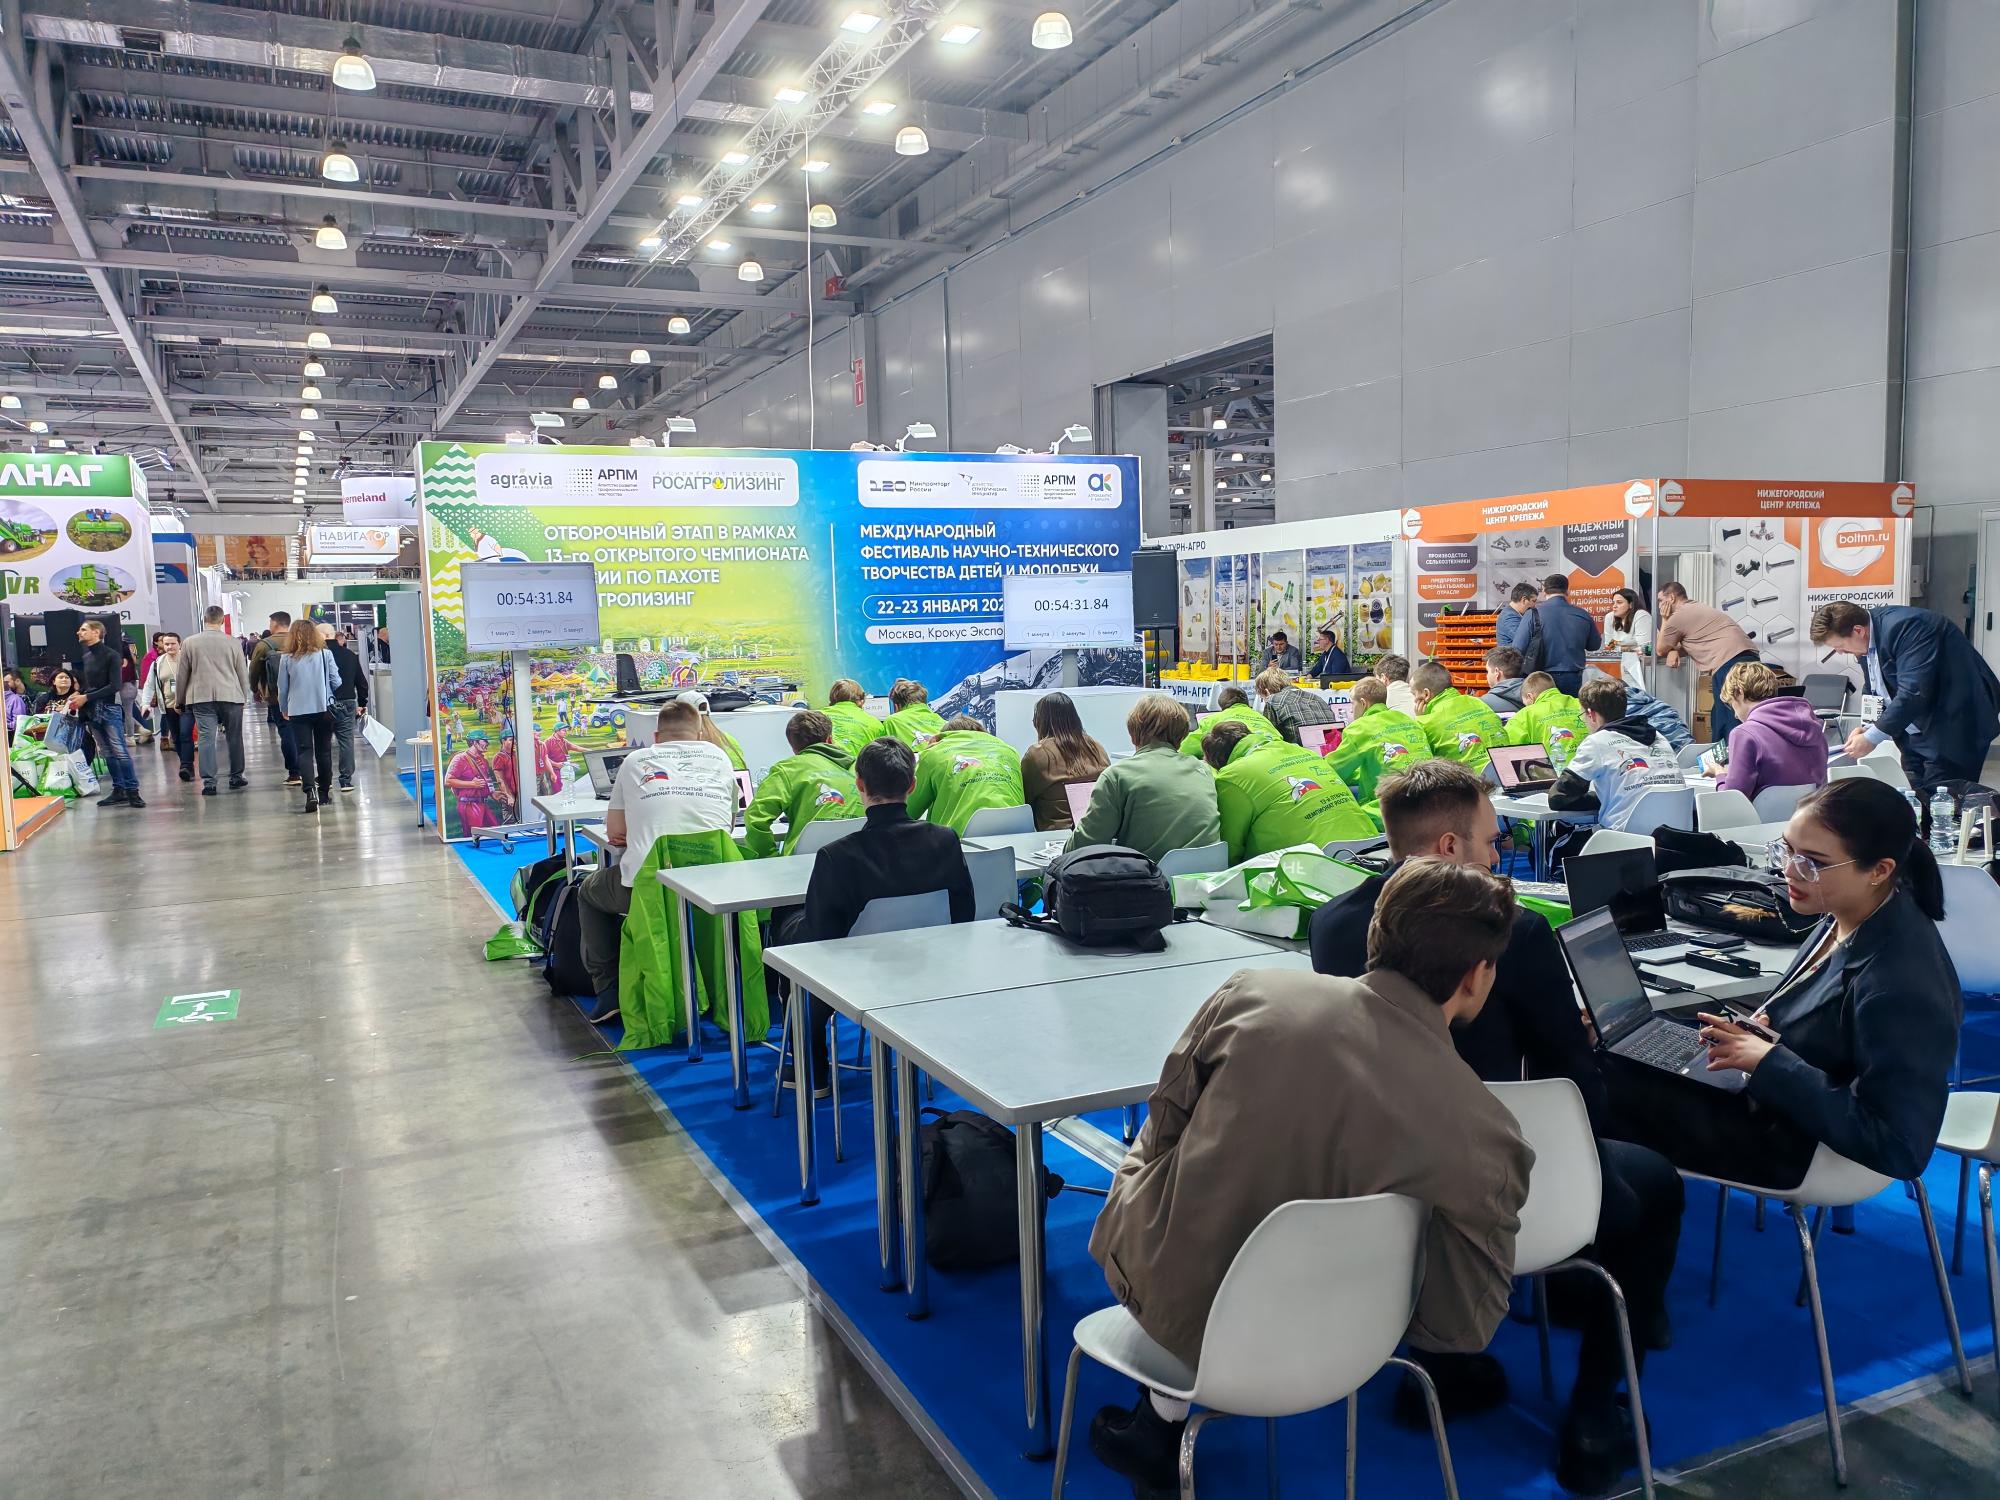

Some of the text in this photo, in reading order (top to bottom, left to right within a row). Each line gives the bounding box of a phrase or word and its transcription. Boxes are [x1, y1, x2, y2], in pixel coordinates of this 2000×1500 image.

[490, 472, 553, 489] agravia
[598, 469, 638, 480] АРПМ
[1043, 475, 1076, 485] АРПМ
[652, 476, 786, 491] РОСАГРОЛИЗИНГ
[1757, 489, 1825, 499] НИЖЕГОРОДСКИЙ
[1482, 500, 1549, 515] НИЖЕГОРОДСКИЙ
[1760, 500, 1821, 510] ЦЕНТР КРЕПЕЖА
[1485, 512, 1545, 525] ЦЕНТР КРЕПЕЖА
[544, 523, 796, 541] ОТБОРОЧНЫЙ ЭТАП В РАМКАХ
[860, 522, 996, 539] МЕЖДУНАРОДНЫЙ
[1839, 532, 1890, 544] boltnn.ru
[594, 546, 697, 563] ОТКРЫТОГО
[701, 546, 810, 562] ЧЕМПИОНАТА
[860, 543, 1119, 559] ФЕСТИВАЛЬ НАУЧНО-ТЕХНИЧЕСКОГО
[1578, 544, 1598, 553] 2001
[1599, 544, 1618, 552] года
[626, 570, 652, 584] ПО
[656, 569, 720, 584] ПАХОТЕ
[861, 565, 956, 580] ТВОРЧЕСТВА
[959, 562, 1002, 581] ДЕТЕЙ
[1006, 565, 1015, 576] И
[497, 591, 573, 606] 00:54:31.84
[1807, 590, 1894, 602] НИЖЕГОРОДСКИЙ
[877, 600, 919, 614] 22-23
[922, 598, 978, 613] ЯНВАРЯ
[1034, 598, 1109, 611] 00:54:31.84
[878, 626, 1004, 640] Москва, Крокус Экспо
